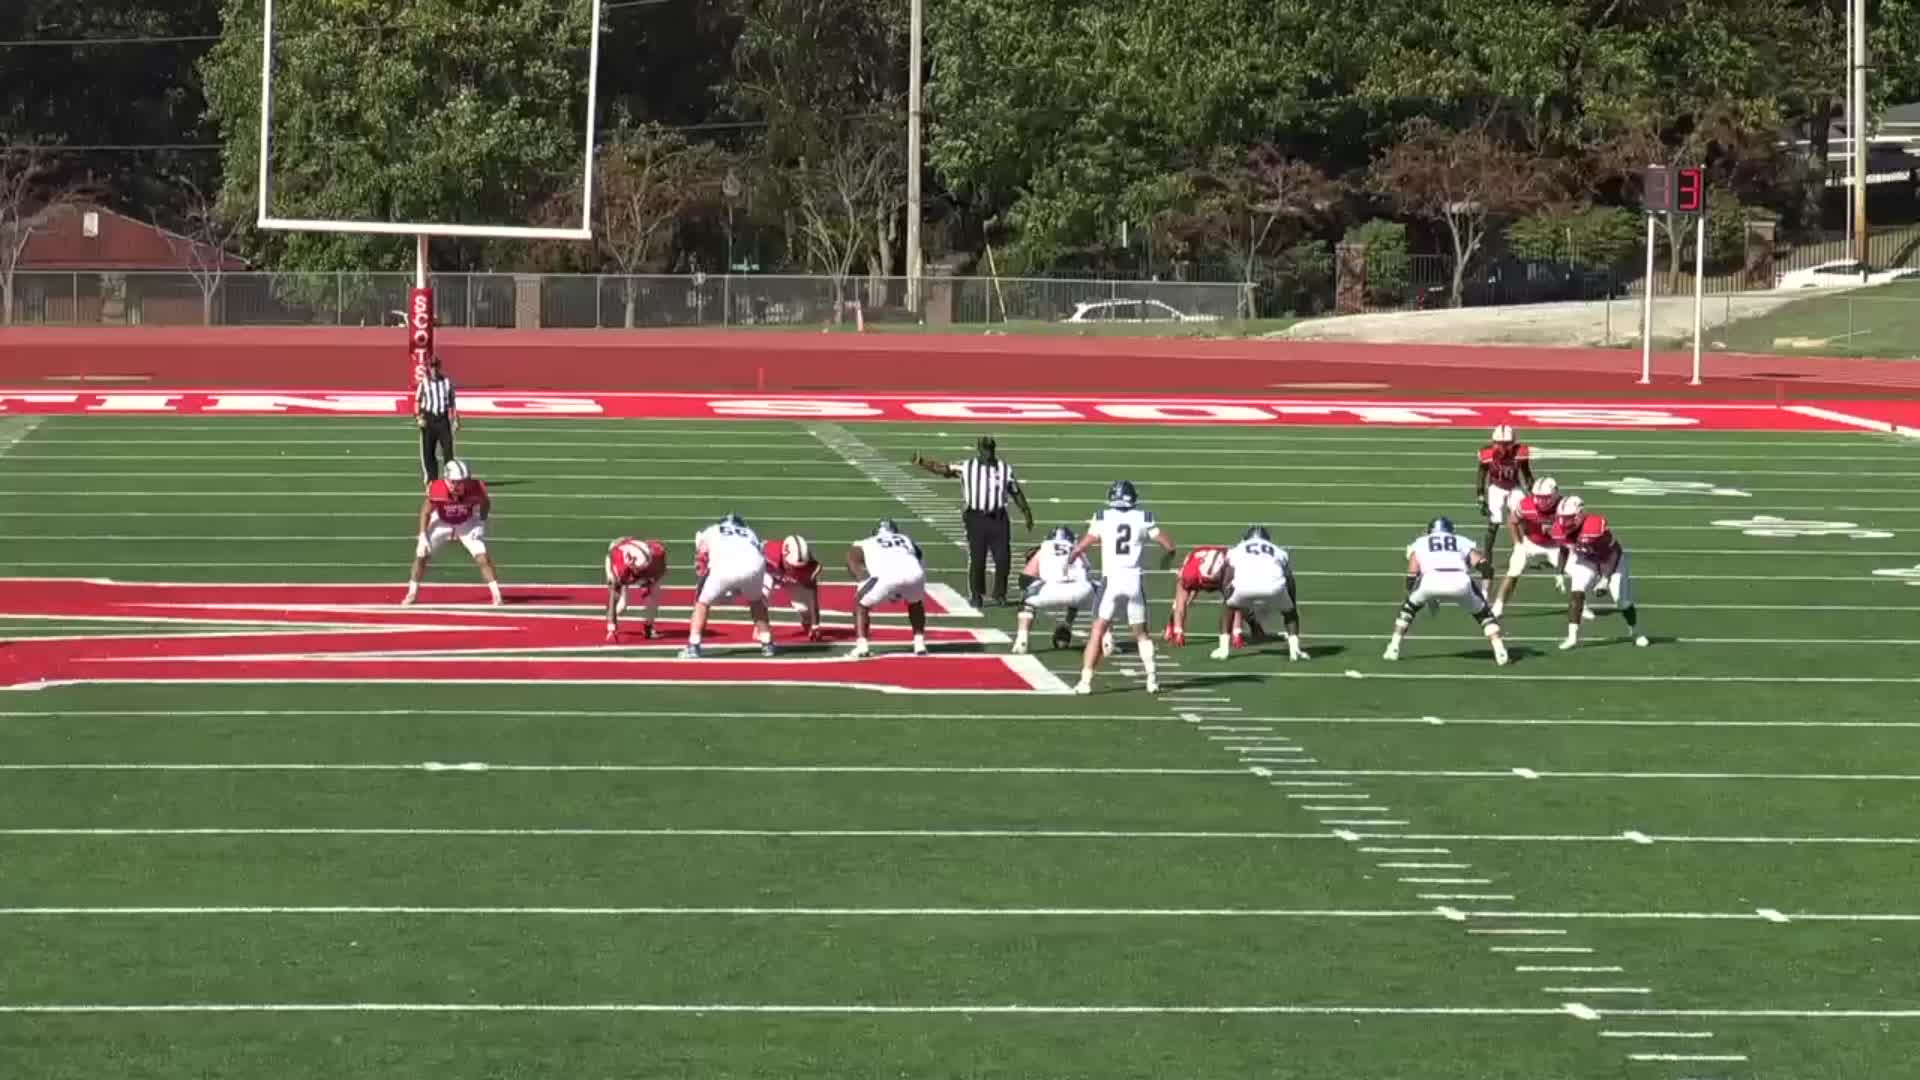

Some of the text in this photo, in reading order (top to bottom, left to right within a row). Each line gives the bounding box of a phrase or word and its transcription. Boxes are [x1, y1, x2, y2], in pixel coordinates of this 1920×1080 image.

[413, 295, 429, 381] SCOTS
[706, 399, 1699, 425] SCOTS
[1116, 523, 1132, 555] 2
[1428, 536, 1458, 553] 68
